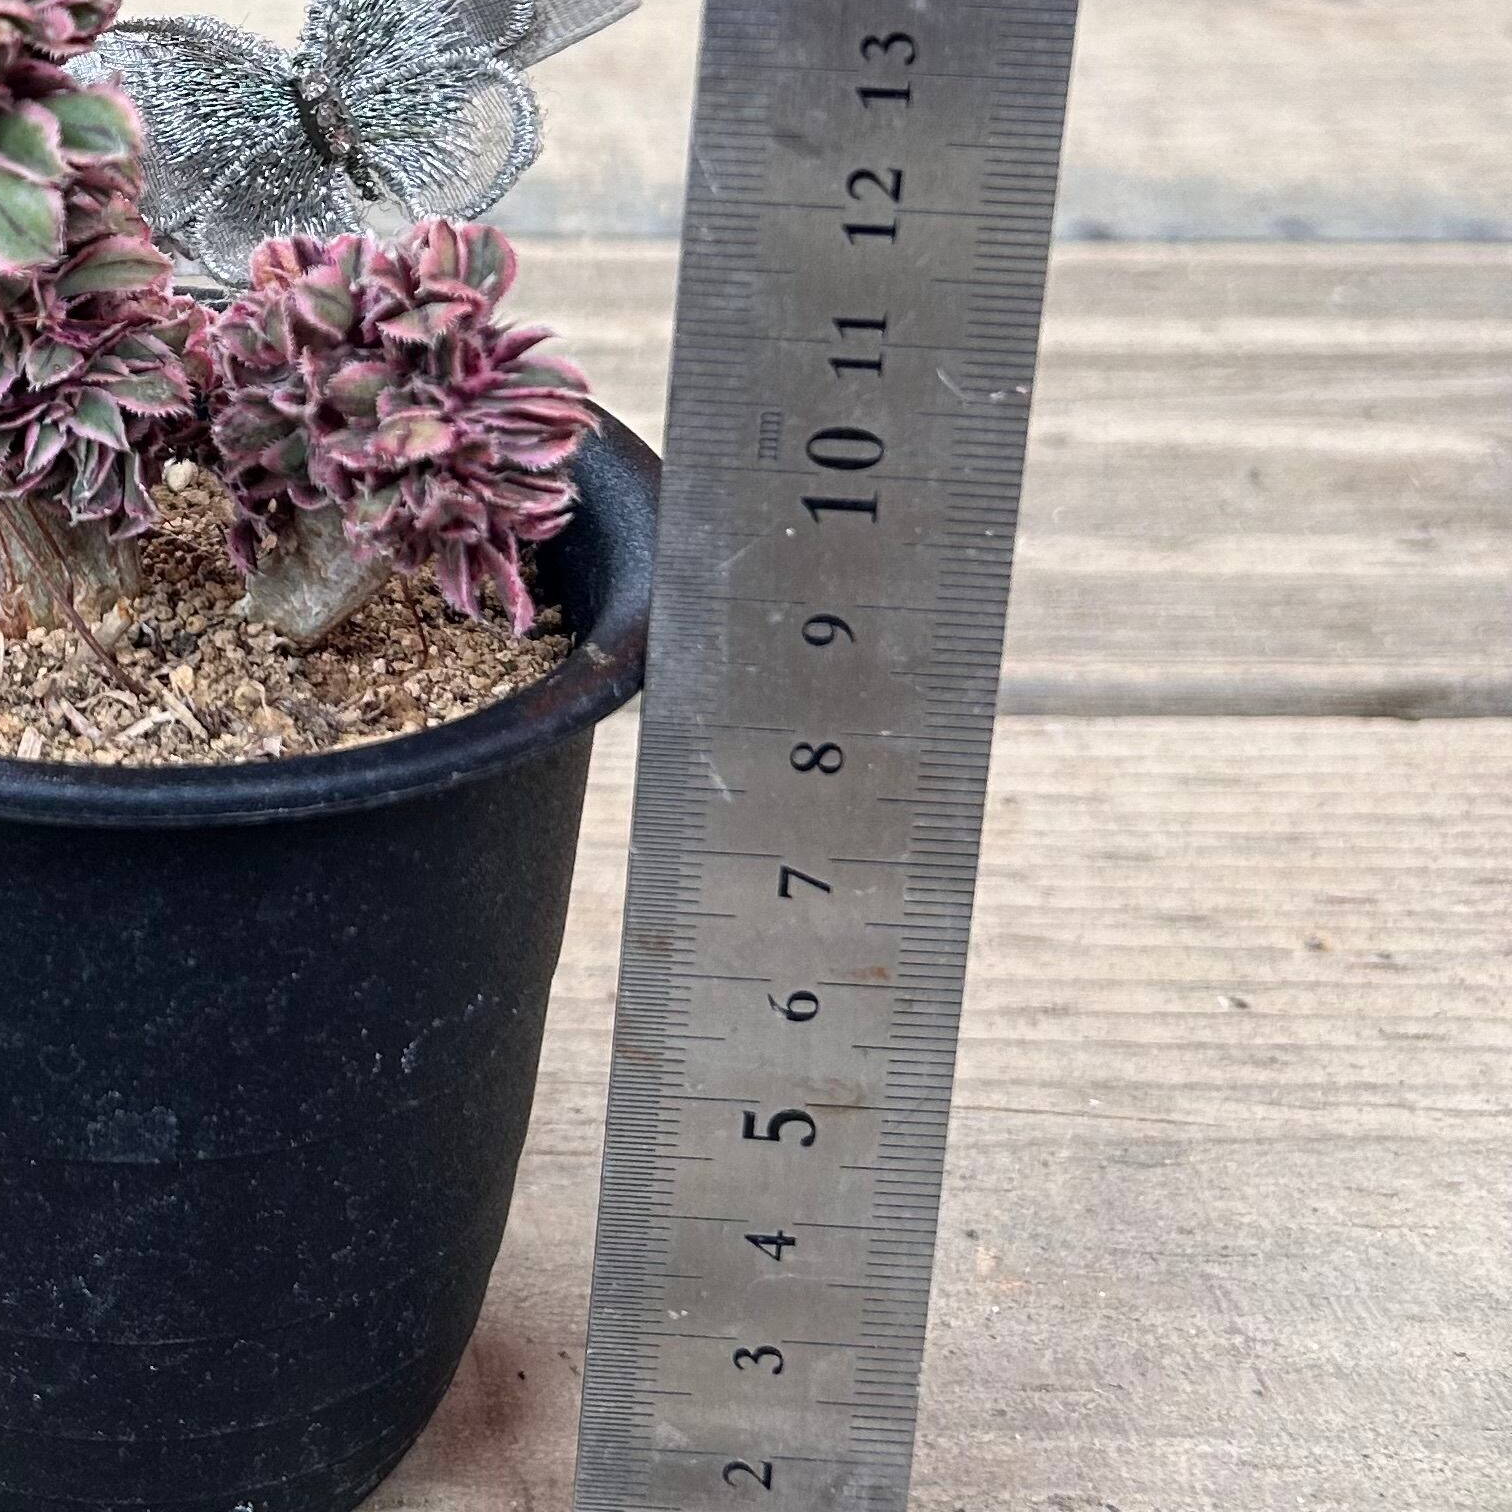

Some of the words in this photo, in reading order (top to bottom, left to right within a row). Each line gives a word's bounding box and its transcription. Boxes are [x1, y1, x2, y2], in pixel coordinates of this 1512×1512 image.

[855, 31, 916, 109] 13
[842, 167, 903, 245] 12
[828, 310, 888, 379] 11
[758, 410, 783, 462] mm
[800, 426, 885, 524] 10
[801, 613, 855, 647] 9
[789, 741, 844, 775] 8
[777, 864, 832, 899] 7
[767, 990, 820, 1022] 6
[742, 1108, 817, 1148] 5
[744, 1229, 796, 1261] 4
[732, 1345, 784, 1375] 3
[722, 1460, 773, 1490] 2
